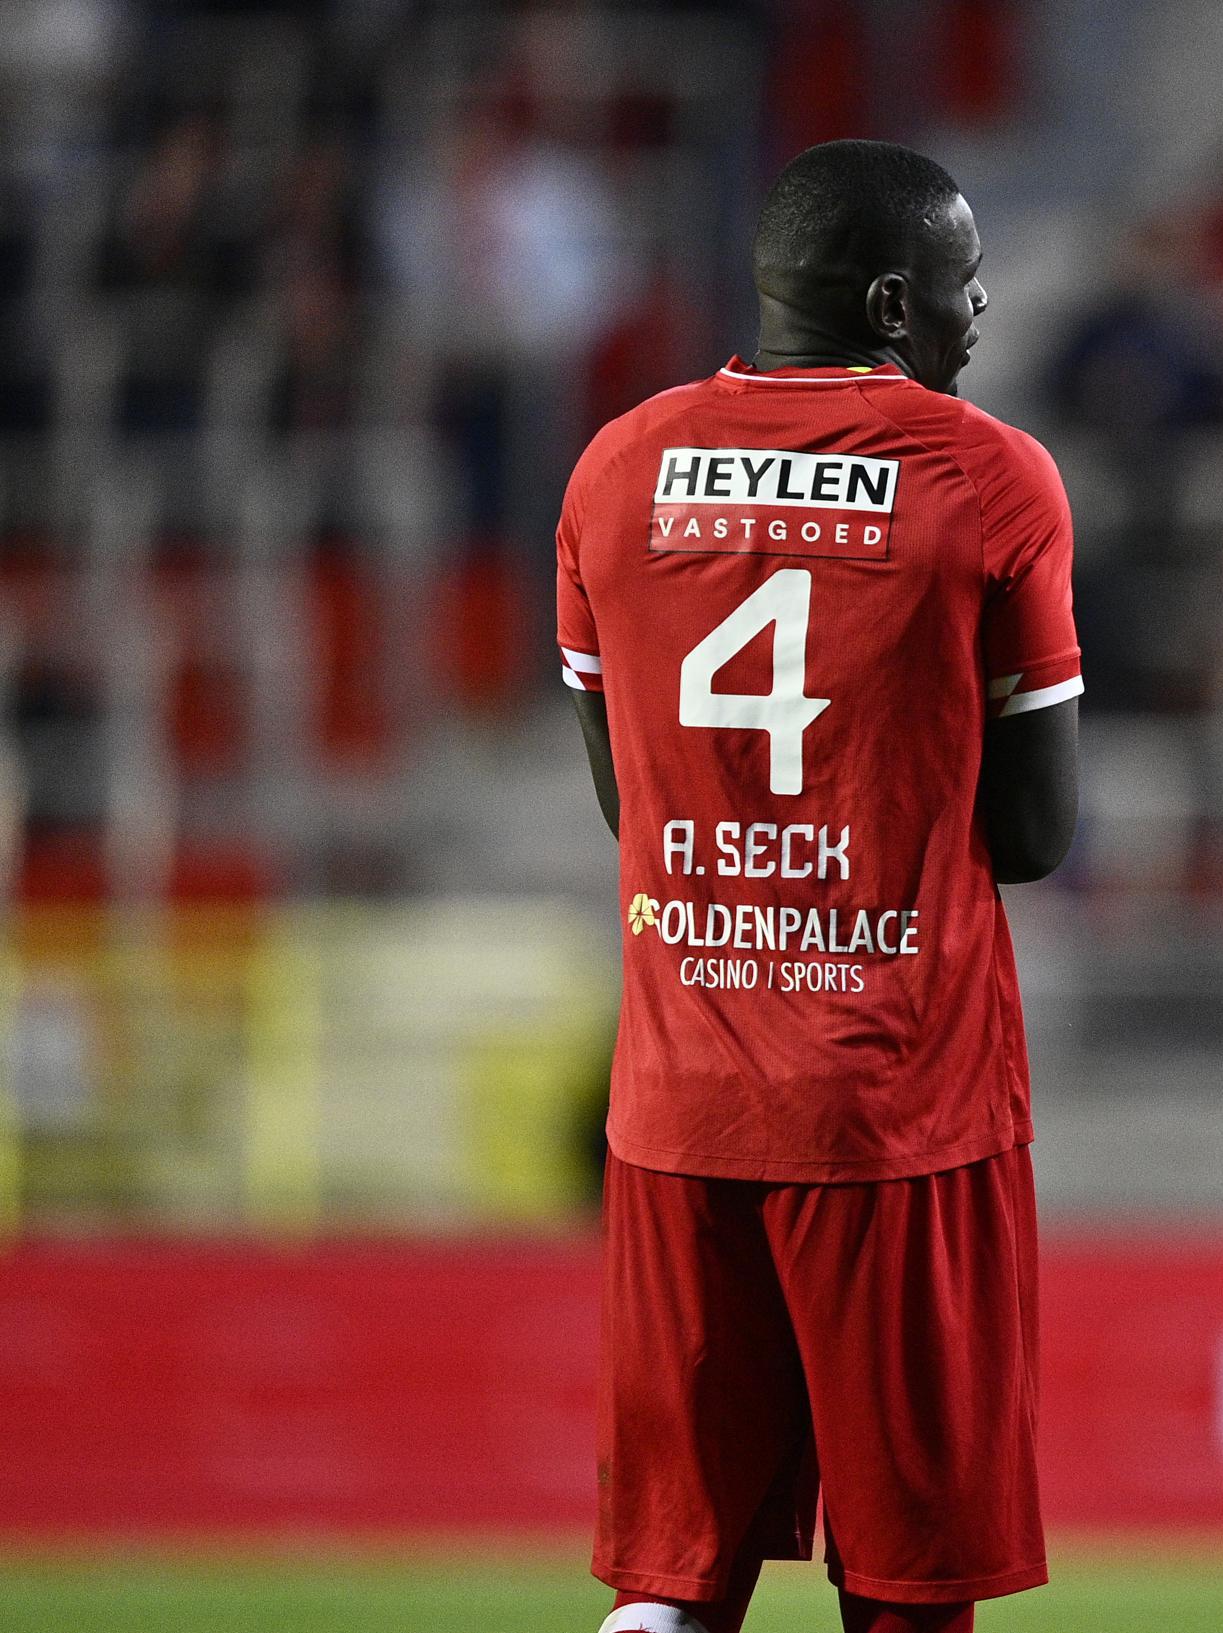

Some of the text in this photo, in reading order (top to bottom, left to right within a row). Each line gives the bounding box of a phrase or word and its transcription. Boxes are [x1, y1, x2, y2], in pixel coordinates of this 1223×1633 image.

[662, 456, 890, 505] HEYLEN
[657, 517, 882, 545] VASTGOED
[679, 568, 831, 795] 4
[680, 957, 758, 989] CASINO
[780, 962, 865, 993] SPORTS
